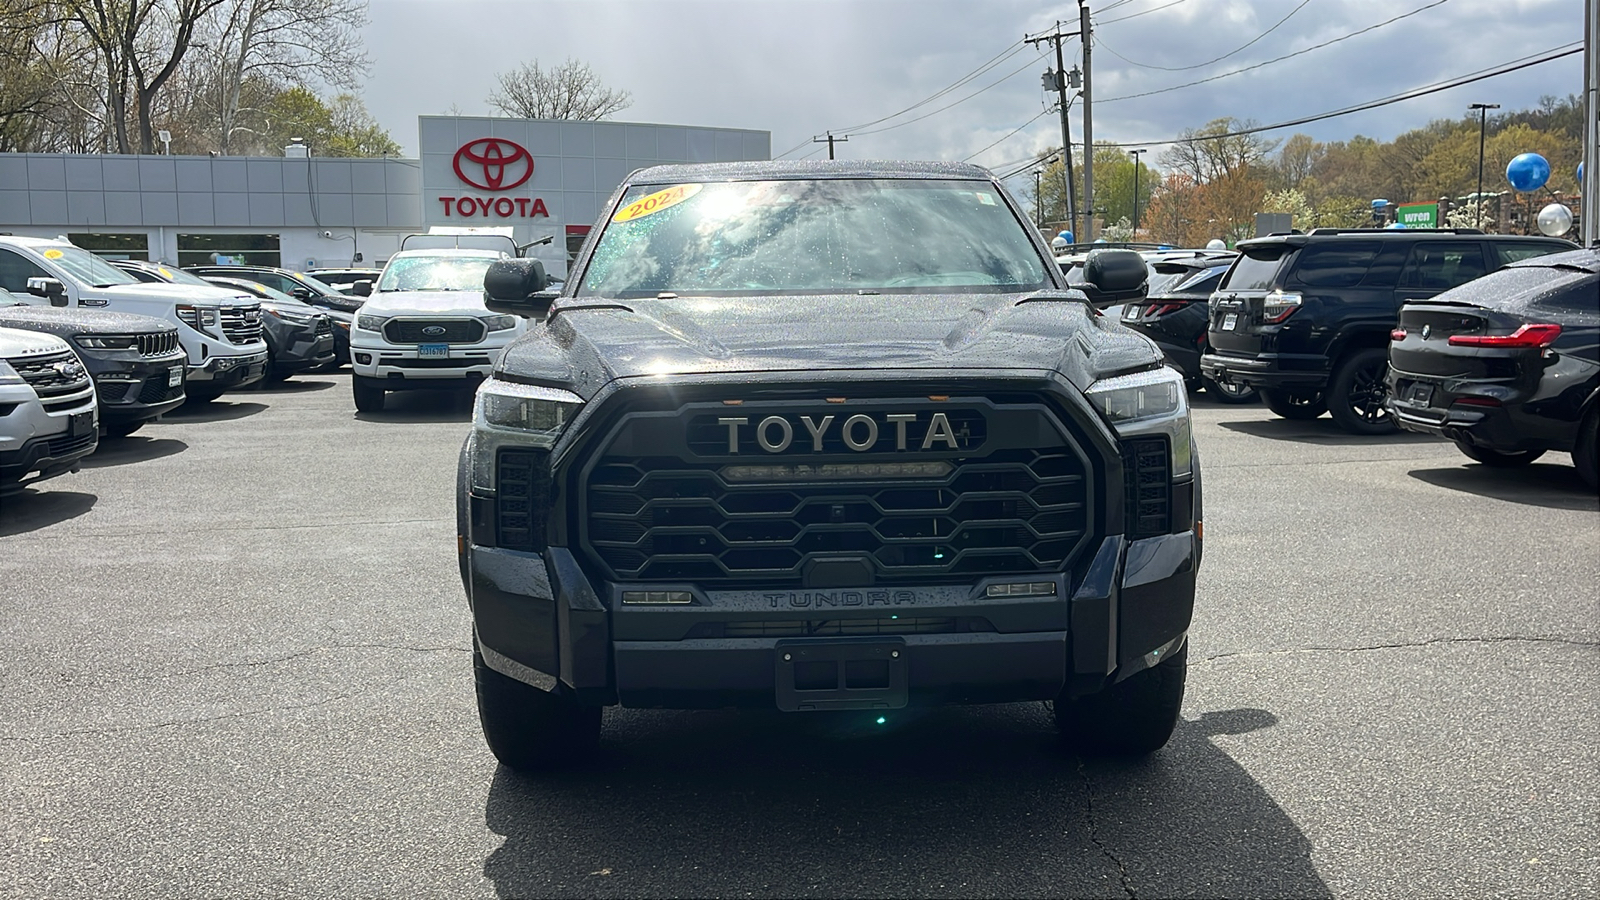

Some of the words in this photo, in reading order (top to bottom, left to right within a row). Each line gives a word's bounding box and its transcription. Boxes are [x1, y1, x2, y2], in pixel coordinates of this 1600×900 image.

[439, 197, 549, 217] TOYOTA
[630, 187, 685, 218] 2024
[1404, 212, 1430, 222] wren
[718, 412, 959, 453] TOYOTA
[763, 590, 916, 608] TUNDRA
